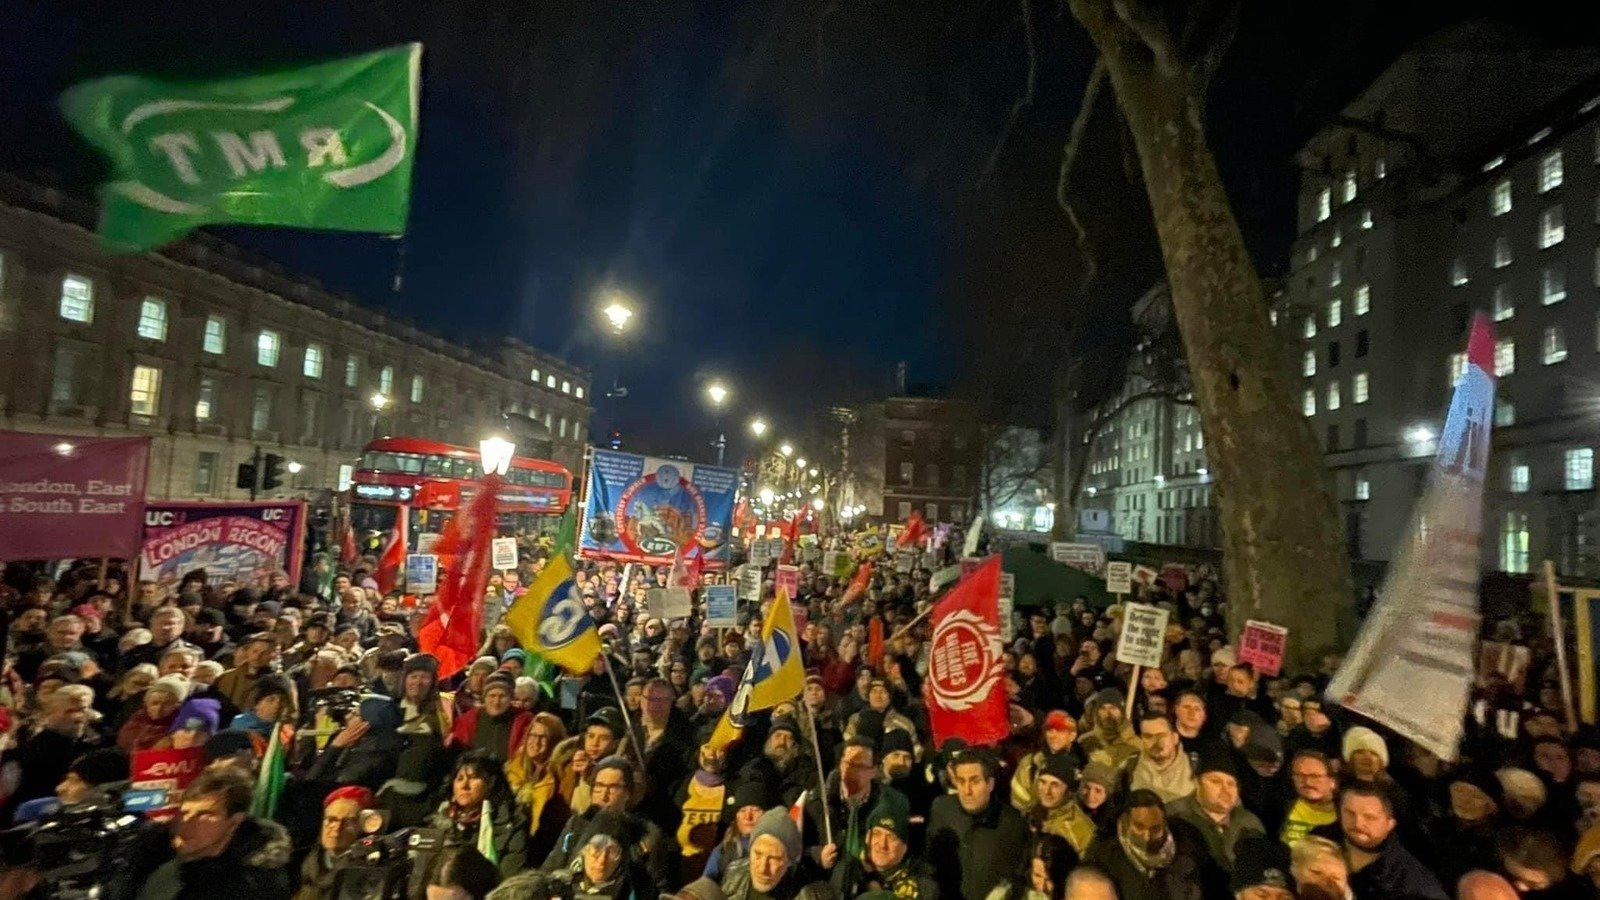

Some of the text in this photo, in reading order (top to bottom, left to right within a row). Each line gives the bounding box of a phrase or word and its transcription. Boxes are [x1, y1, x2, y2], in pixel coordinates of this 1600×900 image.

[86, 480, 133, 496] East
[399, 487, 411, 500] 3
[10, 497, 75, 514] South
[78, 498, 126, 514] East
[150, 526, 222, 565] LONDON
